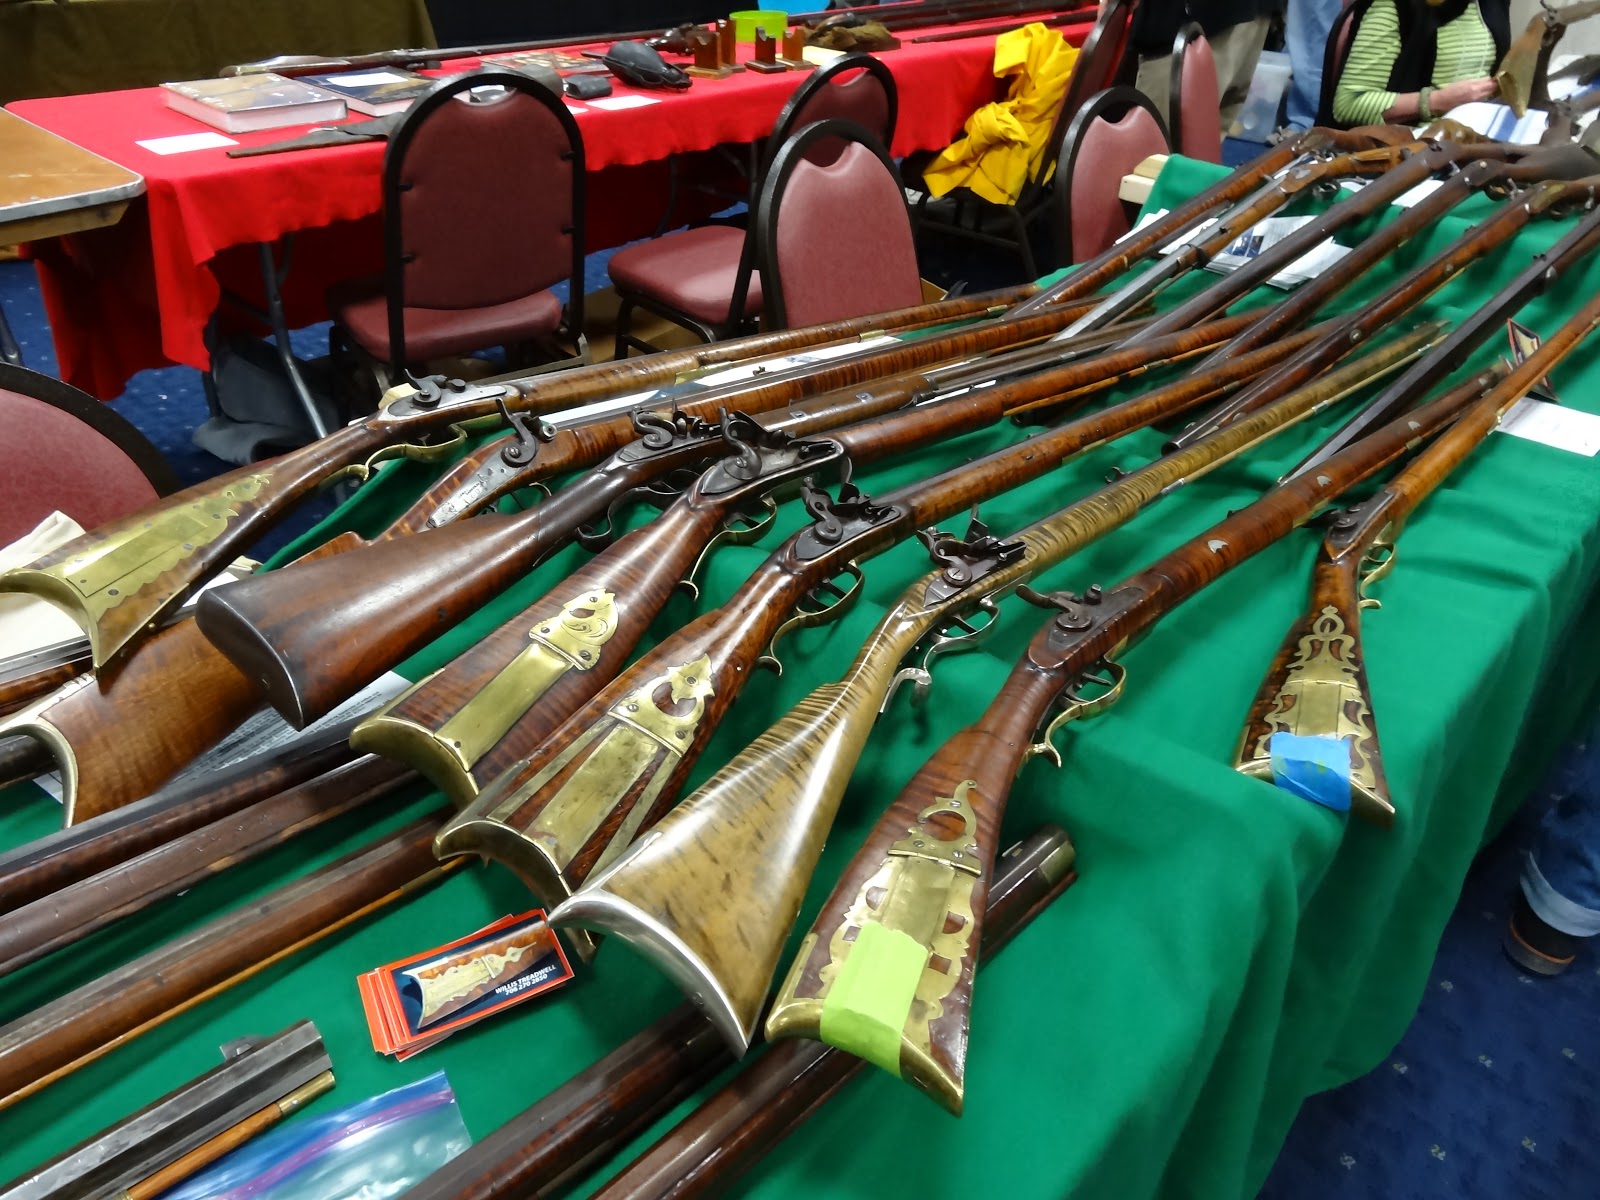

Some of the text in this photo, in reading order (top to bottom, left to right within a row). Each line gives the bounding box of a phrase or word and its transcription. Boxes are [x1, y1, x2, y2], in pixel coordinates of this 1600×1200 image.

[495, 964, 556, 994] WILLIS TREADWELL
[505, 987, 518, 996] 706
[518, 981, 531, 990] 270
